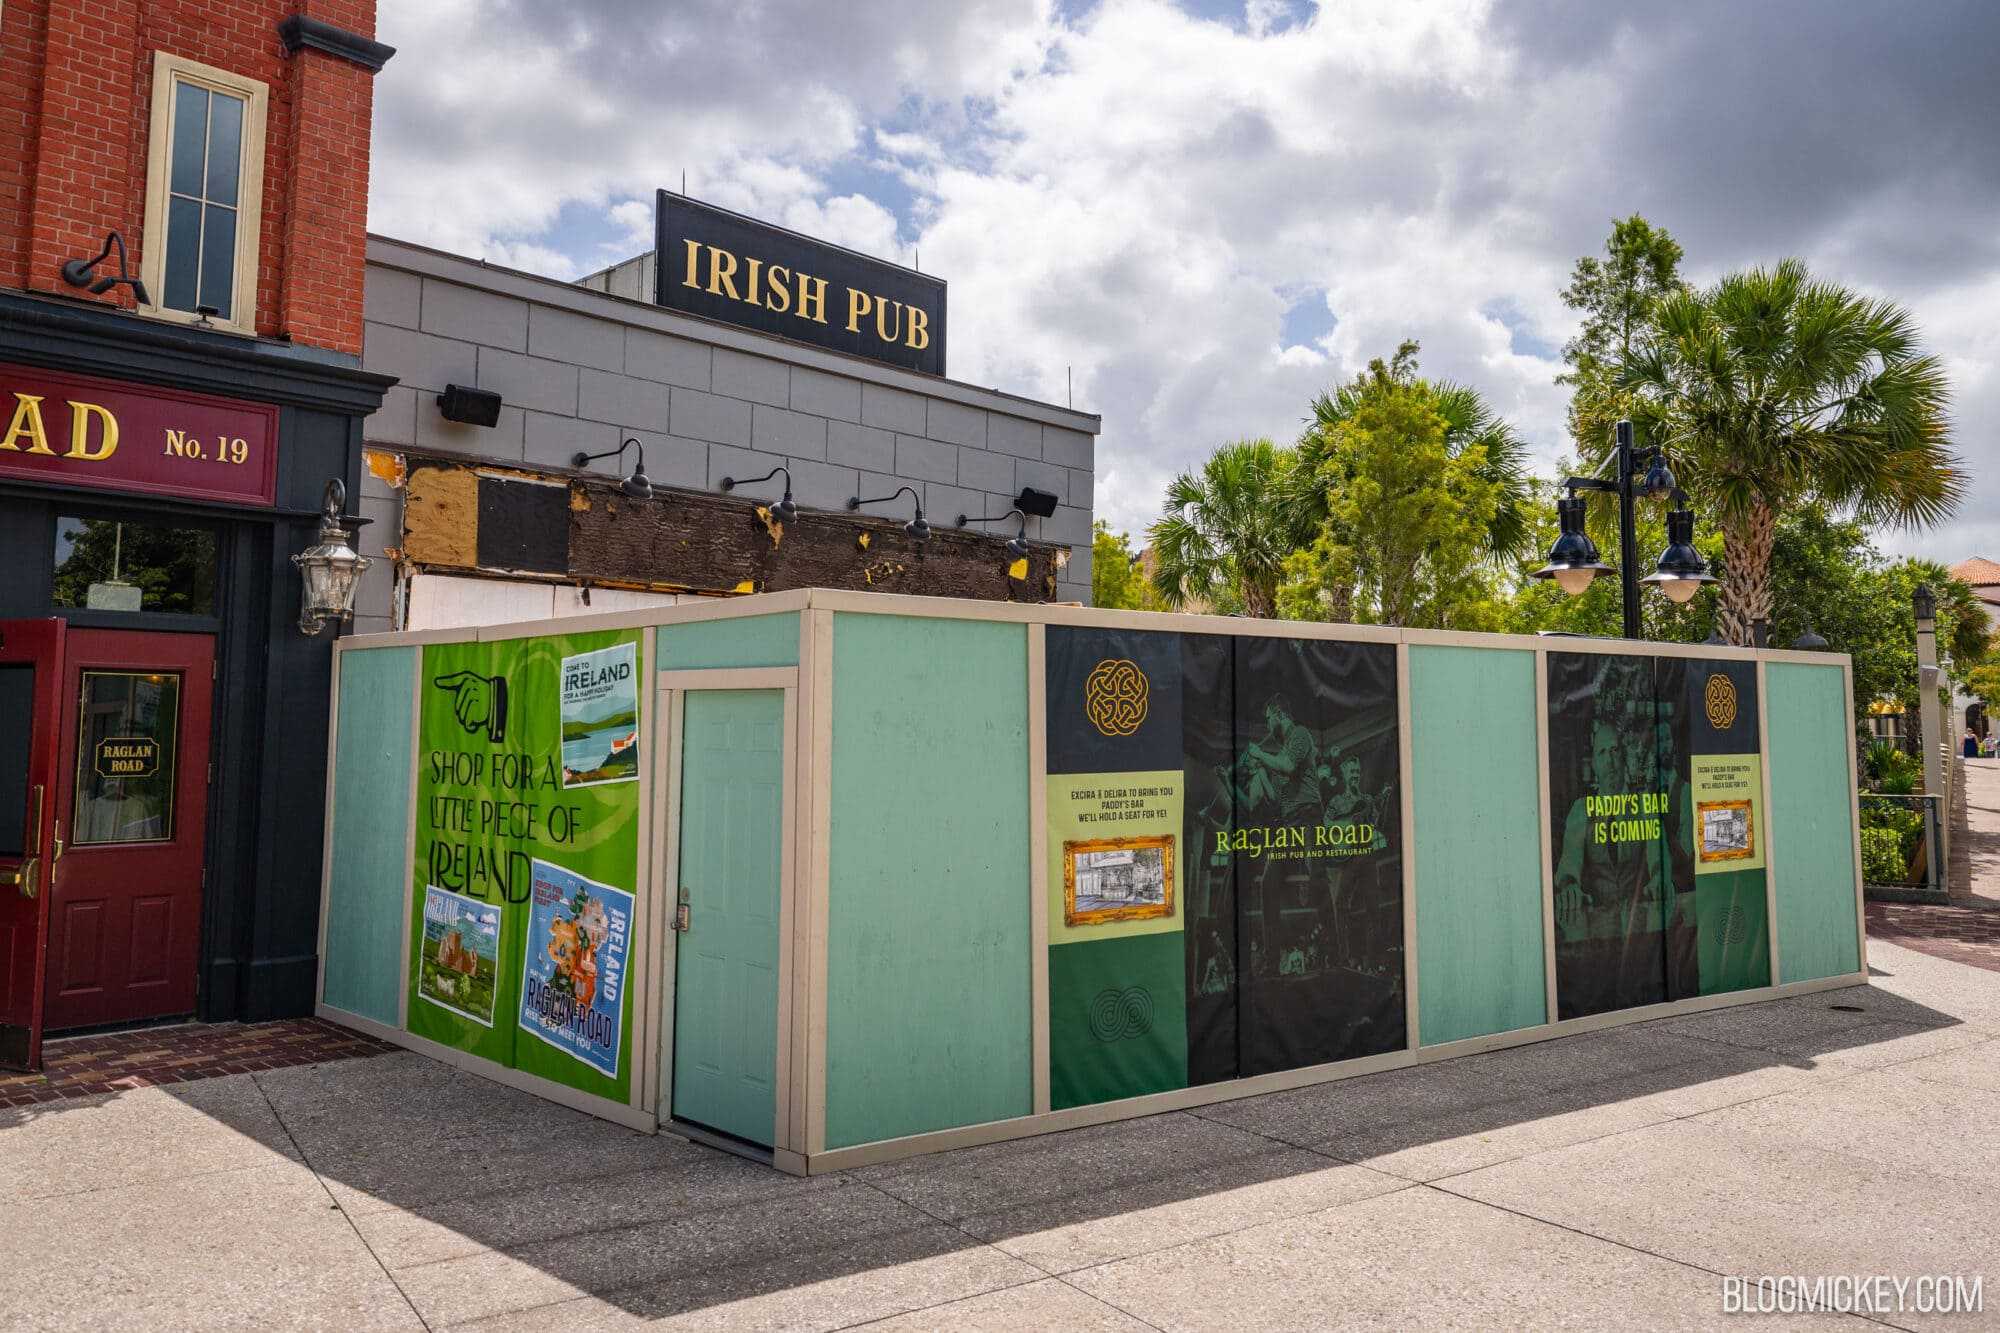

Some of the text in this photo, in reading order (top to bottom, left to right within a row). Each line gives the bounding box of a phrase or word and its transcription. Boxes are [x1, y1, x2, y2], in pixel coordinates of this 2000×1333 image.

[682, 238, 929, 350] IRISH PUB
[163, 429, 207, 460] No.
[216, 436, 248, 464] 19
[564, 663, 630, 691] IRELAND
[103, 745, 153, 758] RAGLAN
[111, 760, 144, 772] ROAD
[431, 750, 557, 791] SHOP FOR A
[1071, 790, 1096, 800] EXCIRA
[1104, 789, 1127, 799] DELIRA
[1129, 788, 1136, 797] TO
[1138, 787, 1158, 797] BRING
[1160, 787, 1173, 796] YOU
[1101, 799, 1144, 810] PADDY'S BAR
[1586, 793, 1669, 817] PADDY'S BAR
[430, 796, 581, 843] LITTLE PIECE OF
[1079, 813, 1097, 822] WE'LL
[1099, 812, 1117, 821] HOLD
[1118, 811, 1123, 820] A
[1124, 810, 1140, 820] SEAT
[1142, 810, 1154, 819] FOR
[1595, 819, 1660, 844] IS COMING
[1267, 847, 1372, 860] IRISH PUB AND RESTAURANT
[429, 840, 531, 903] IRELAND
[604, 907, 626, 1001] IRELAND
[527, 976, 612, 1049] RAGLAN ROAD
[558, 1026, 575, 1042] MEET
[576, 1036, 591, 1050] YOU
